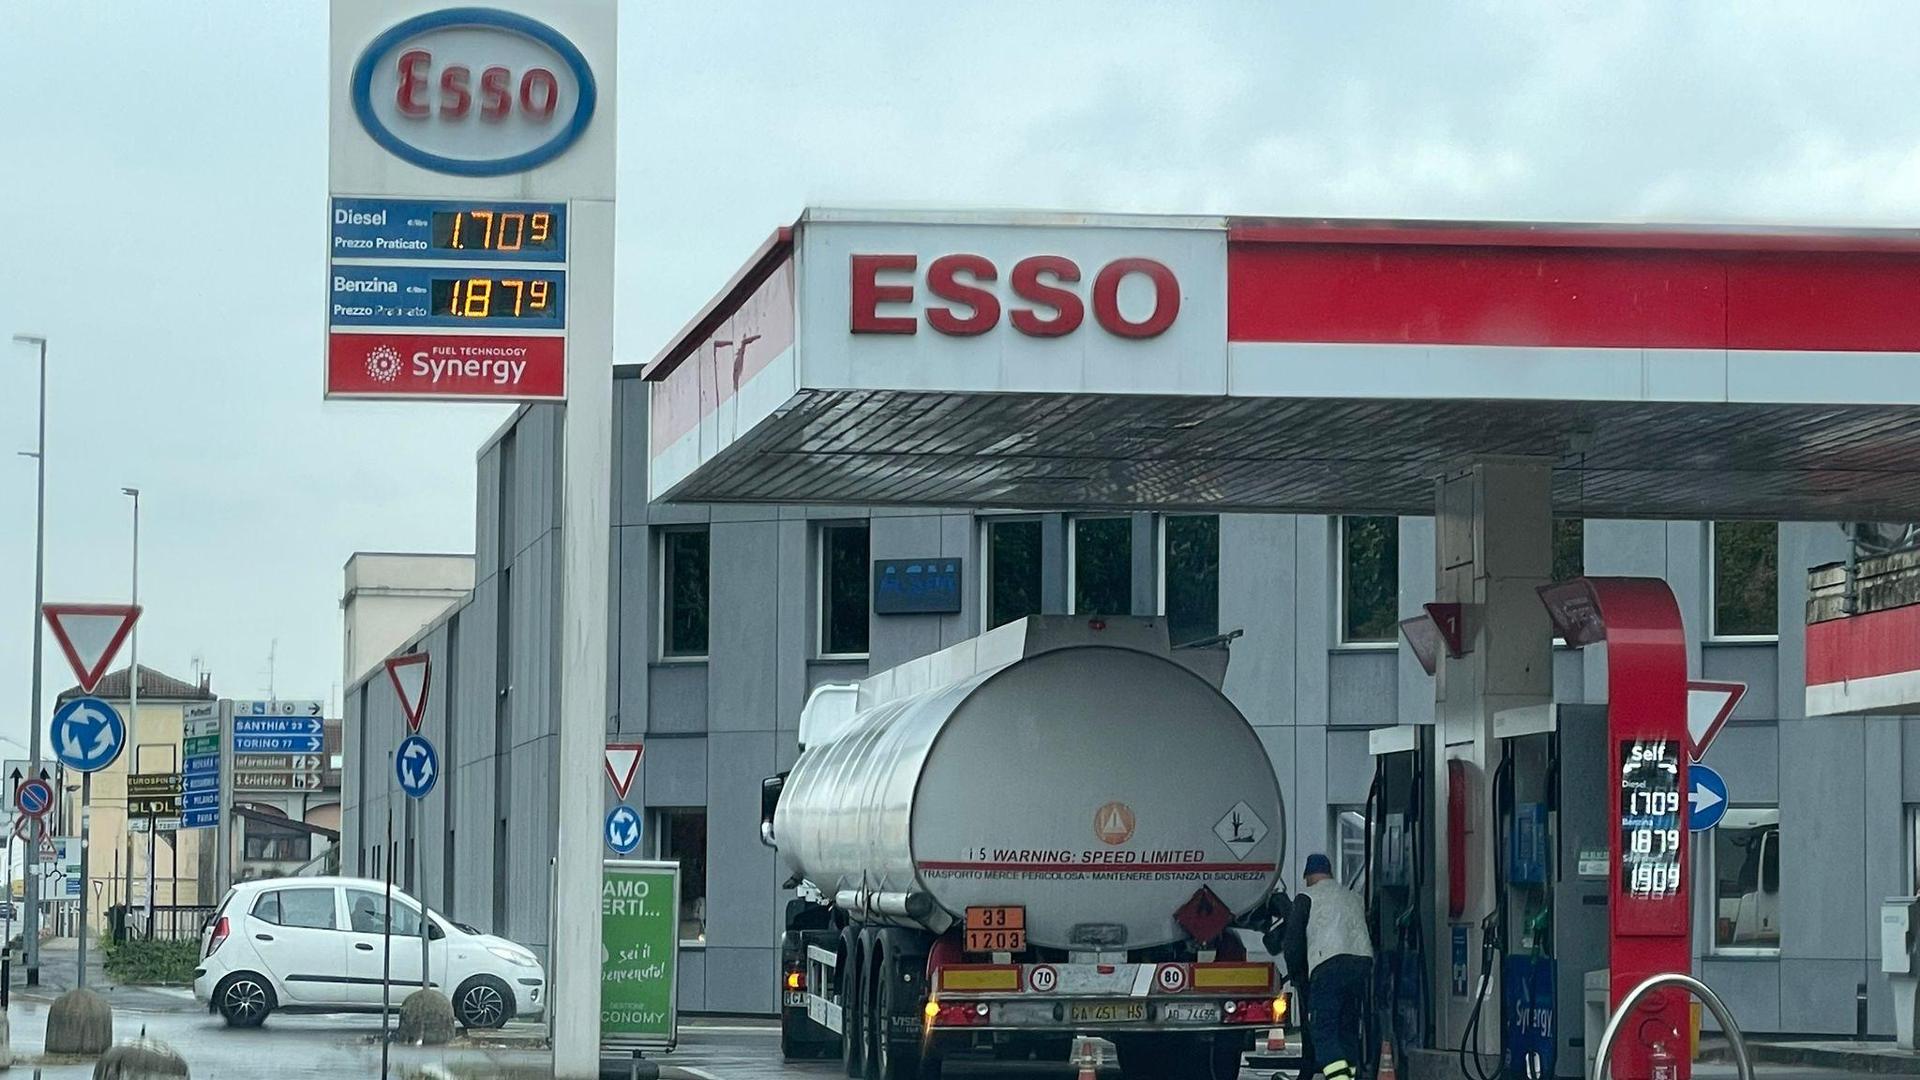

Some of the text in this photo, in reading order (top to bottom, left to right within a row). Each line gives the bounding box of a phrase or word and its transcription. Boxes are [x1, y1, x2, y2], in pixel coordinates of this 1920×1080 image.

[396, 49, 560, 120] Esso
[335, 208, 387, 225] Diesel
[334, 236, 428, 250] Prezzo Praticato
[334, 276, 398, 293] Benzina
[850, 253, 1181, 339] ESSO
[334, 304, 373, 316] Prezzo
[432, 346, 527, 356] FUEL TECHNOLOGY
[412, 351, 527, 384] Synergy
[236, 738, 293, 749] TORINO 77
[1631, 744, 1666, 761] Self
[1630, 792, 1679, 815] 1709
[1630, 829, 1680, 853] 1879
[993, 849, 1076, 863] WARNING:
[1081, 851, 1136, 864] SPEED
[1141, 850, 1205, 863] LIMITED
[922, 870, 981, 880] TRASPORTO
[984, 871, 1019, 880] MERCE
[1021, 872, 1084, 881] PERICOLOSA
[1092, 872, 1152, 881] MANTENERE
[1155, 872, 1200, 881] DISTANZA
[1202, 873, 1212, 881] DI
[1214, 872, 1266, 881] SICUREZZA
[983, 909, 1006, 926] 33
[970, 932, 1020, 949] 1203
[618, 943, 650, 963] sei il
[1037, 972, 1051, 985] 70
[1164, 970, 1179, 983] 80
